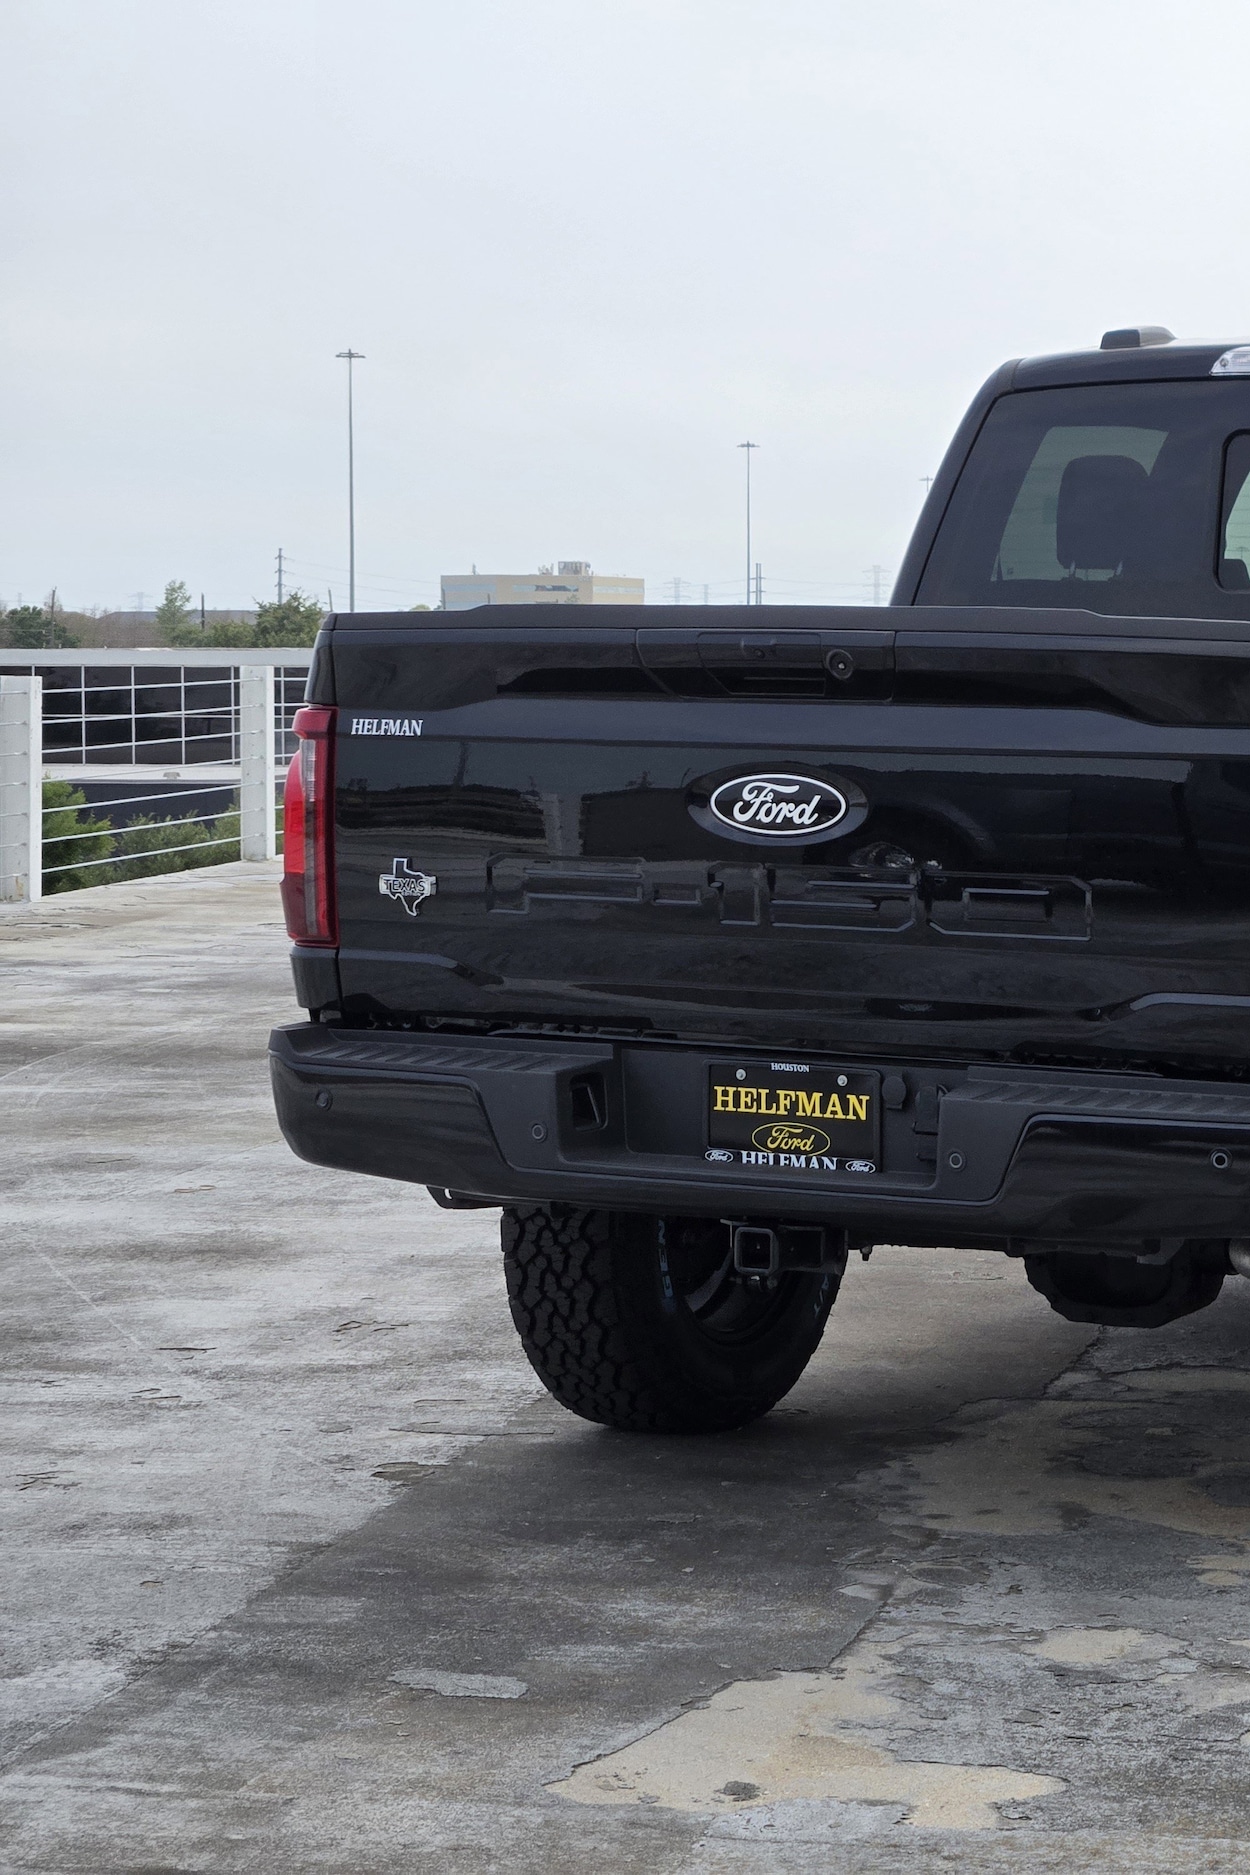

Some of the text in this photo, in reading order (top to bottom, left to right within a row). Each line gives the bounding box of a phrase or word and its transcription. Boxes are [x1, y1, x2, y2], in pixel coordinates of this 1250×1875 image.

[351, 718, 423, 737] HELFMAN
[733, 781, 822, 825] Ford
[383, 878, 426, 892] TEXAS
[770, 1062, 810, 1073] HOUSTON
[713, 1085, 870, 1121] HELFMAN
[766, 1126, 816, 1151] Ford
